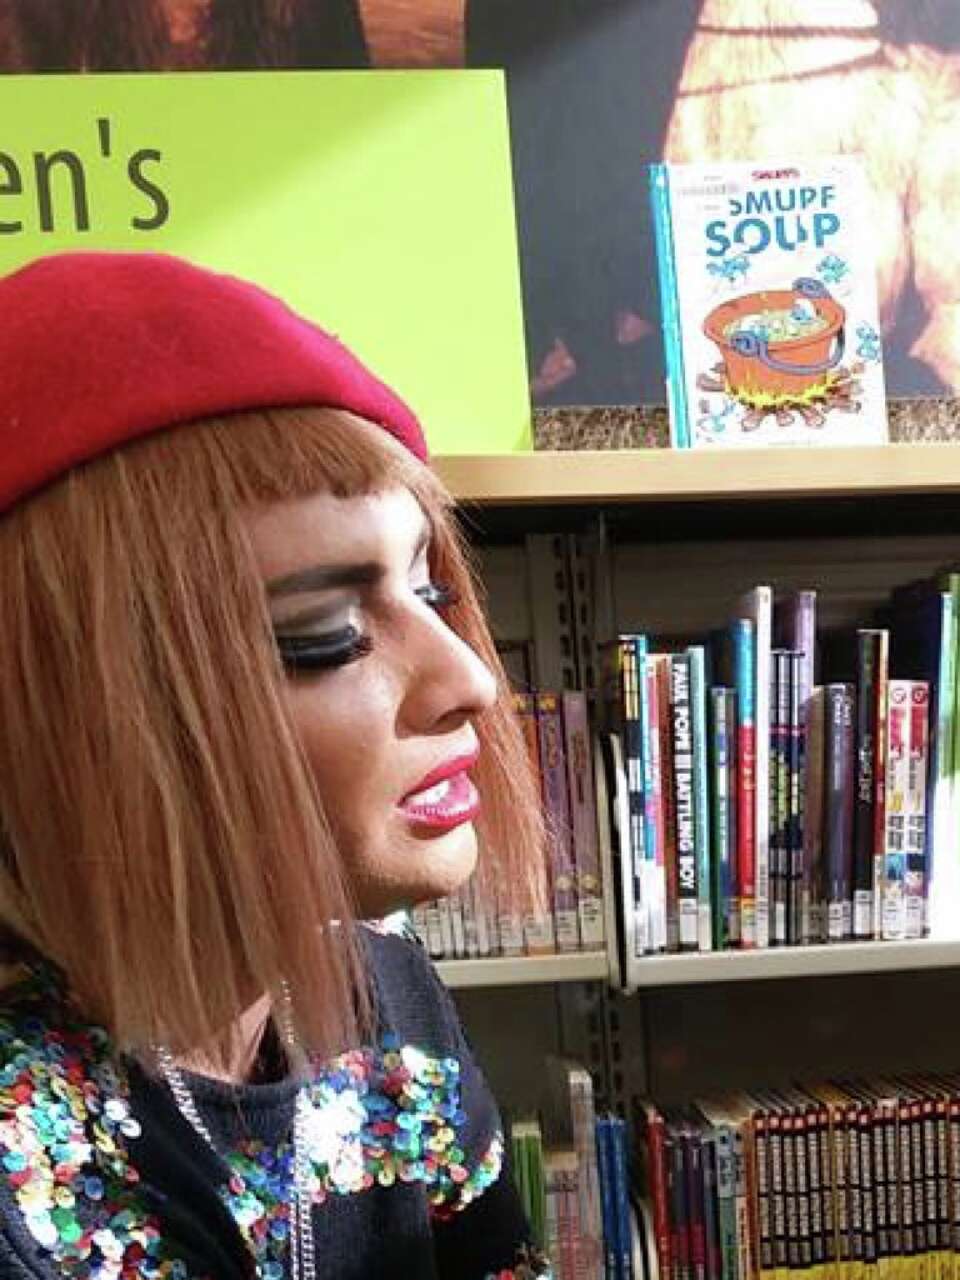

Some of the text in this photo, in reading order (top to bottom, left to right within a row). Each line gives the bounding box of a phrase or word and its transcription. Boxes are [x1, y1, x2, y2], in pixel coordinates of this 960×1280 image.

[706, 213, 841, 257] SOUP
[674, 663, 689, 704] PAUL
[675, 705, 691, 750] POPE
[676, 773, 694, 852] BATTLING
[679, 855, 695, 889] BOY
